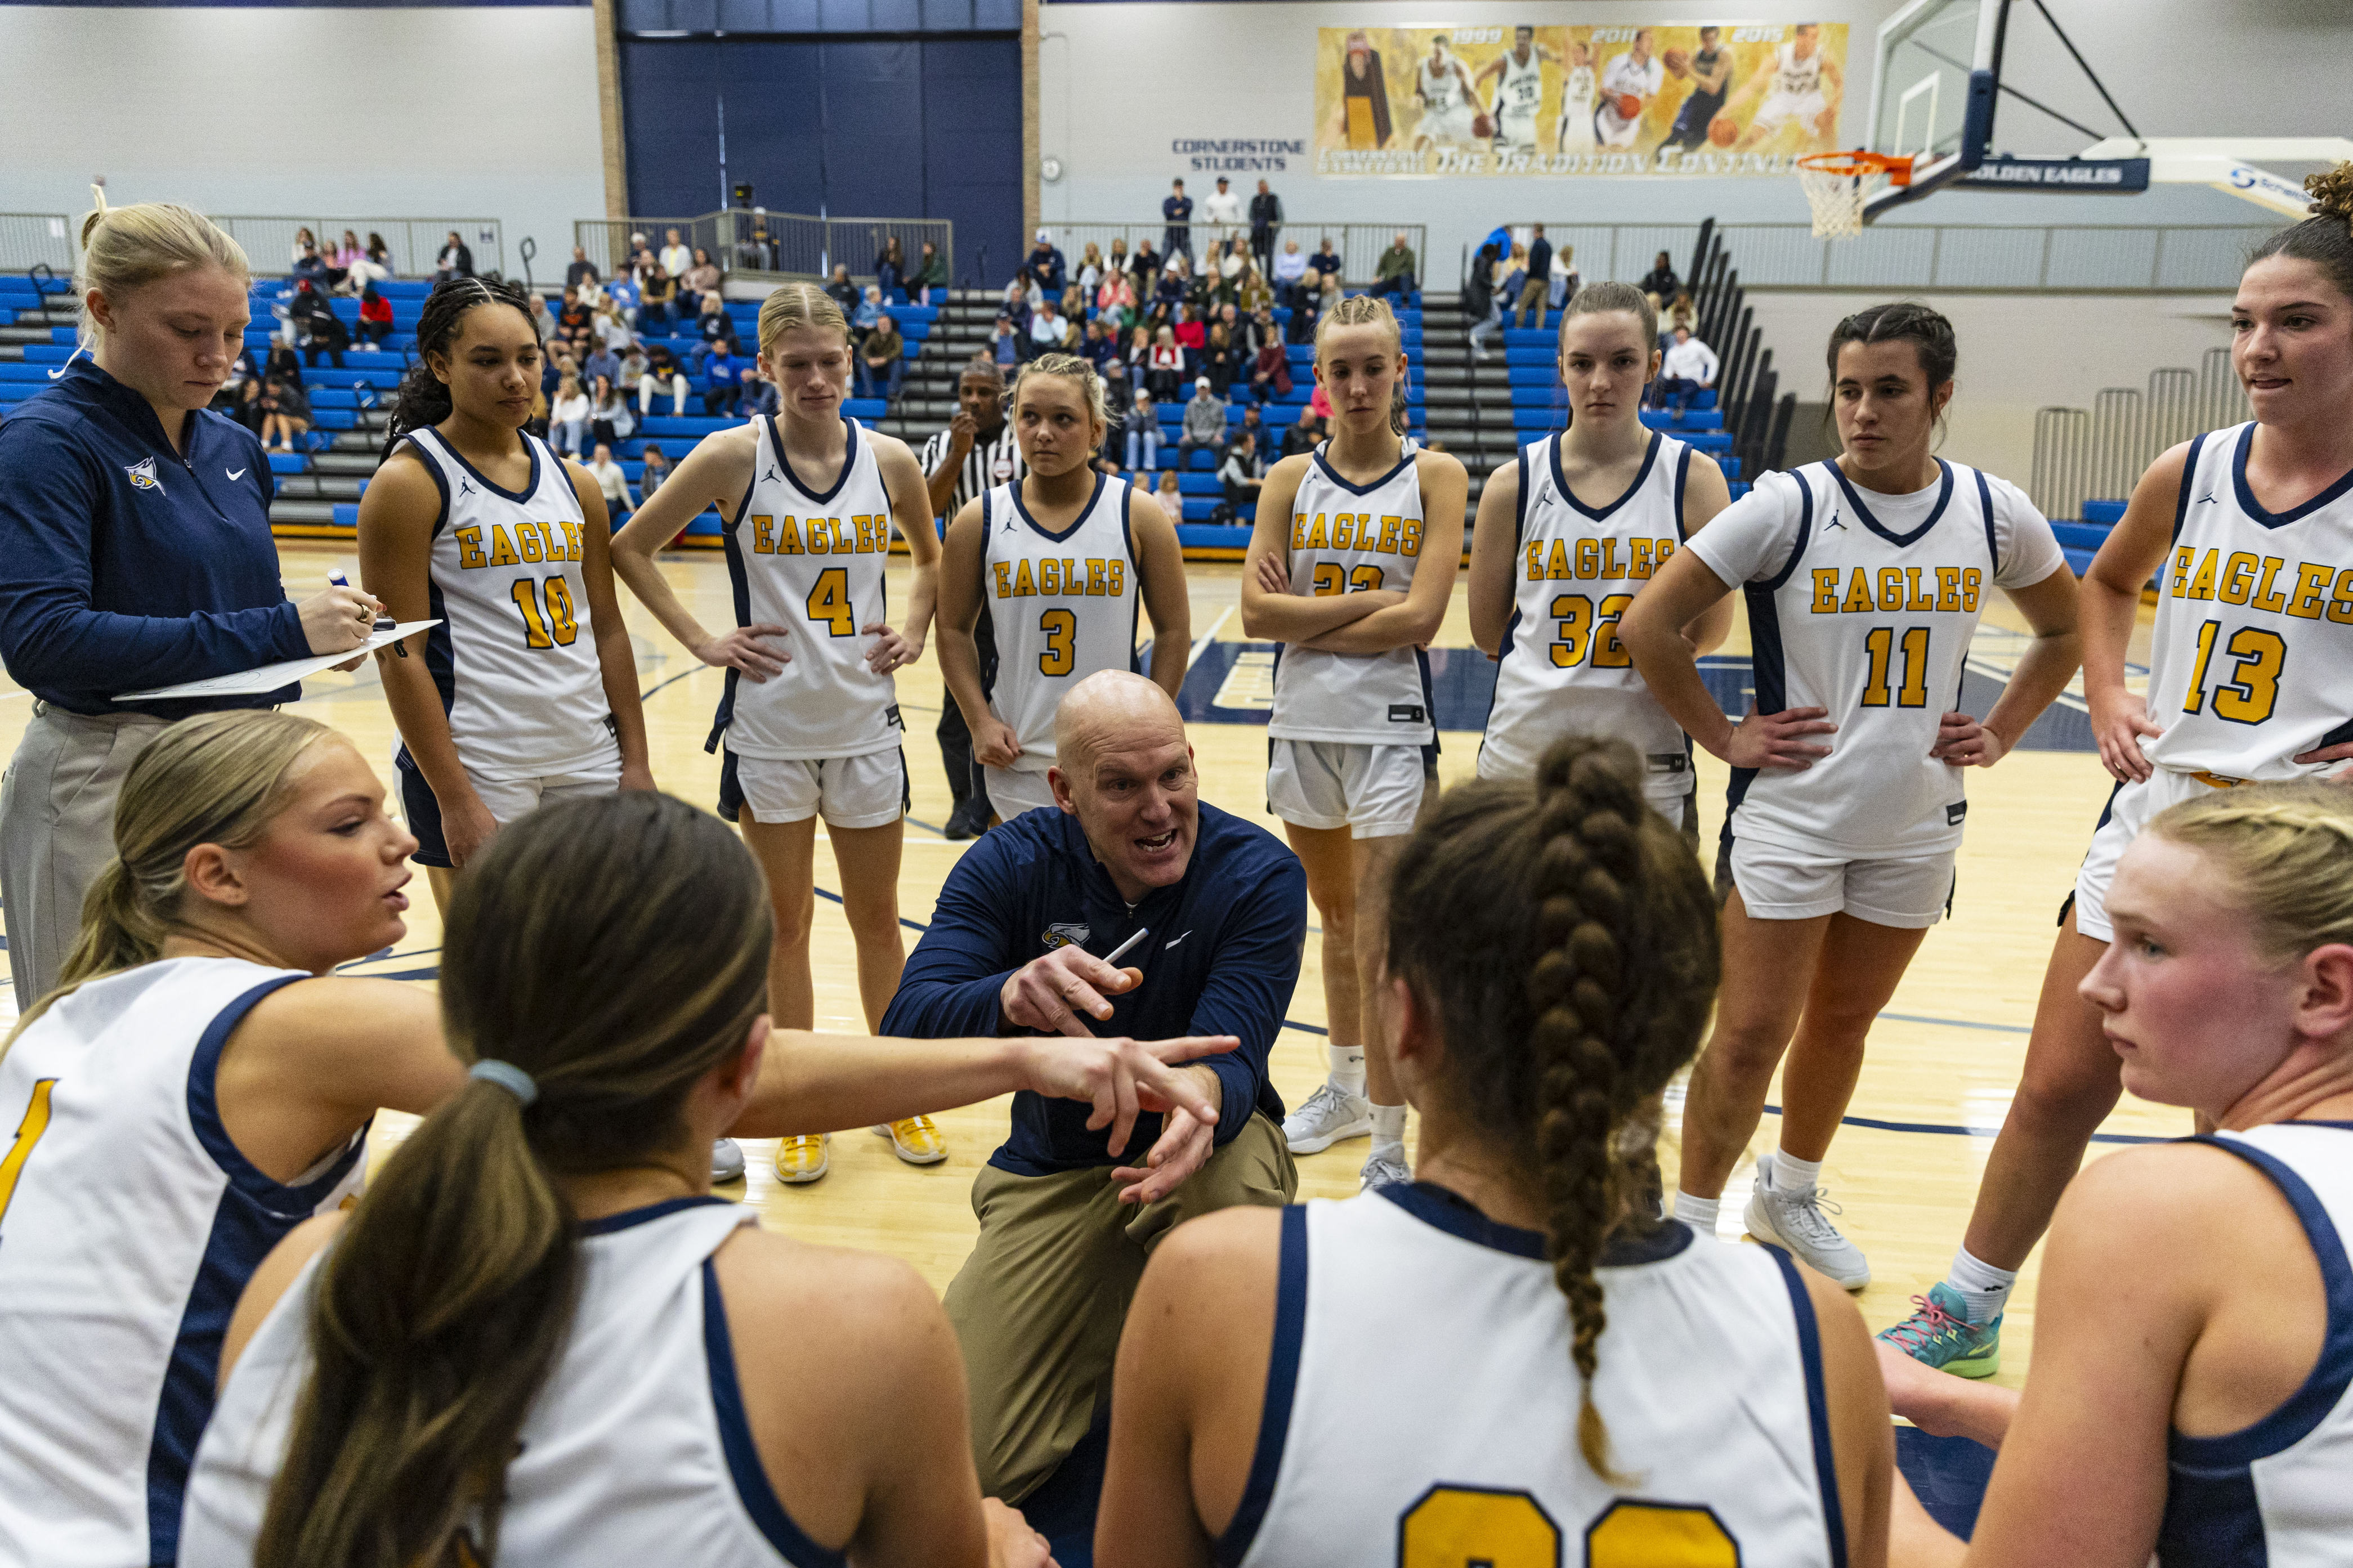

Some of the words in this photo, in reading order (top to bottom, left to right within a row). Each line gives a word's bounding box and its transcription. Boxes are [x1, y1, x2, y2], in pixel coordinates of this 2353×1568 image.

[1452, 29, 1503, 44] 1999
[1591, 28, 1636, 43] 2011
[1731, 27, 1785, 43] 2015
[1172, 138, 1305, 155] CORNERSTONE
[1190, 156, 1287, 171] STUDENTS
[1435, 146, 1483, 174] THE
[1495, 146, 1648, 174] TRADITION
[2043, 166, 2122, 183] EAGLES
[751, 514, 888, 555] EAGLES
[1292, 512, 1422, 557] EAGLES
[993, 558, 1125, 599] EAGLES
[1526, 537, 1675, 581] EAGLES
[806, 567, 856, 638] 4
[1810, 567, 1982, 614] EAGLES
[2172, 545, 2353, 625] EAGLES
[510, 574, 579, 649] 10
[1549, 593, 1635, 669] 32
[1039, 608, 1077, 677] 3
[1860, 626, 1931, 709] 11
[2182, 619, 2288, 727] 13
